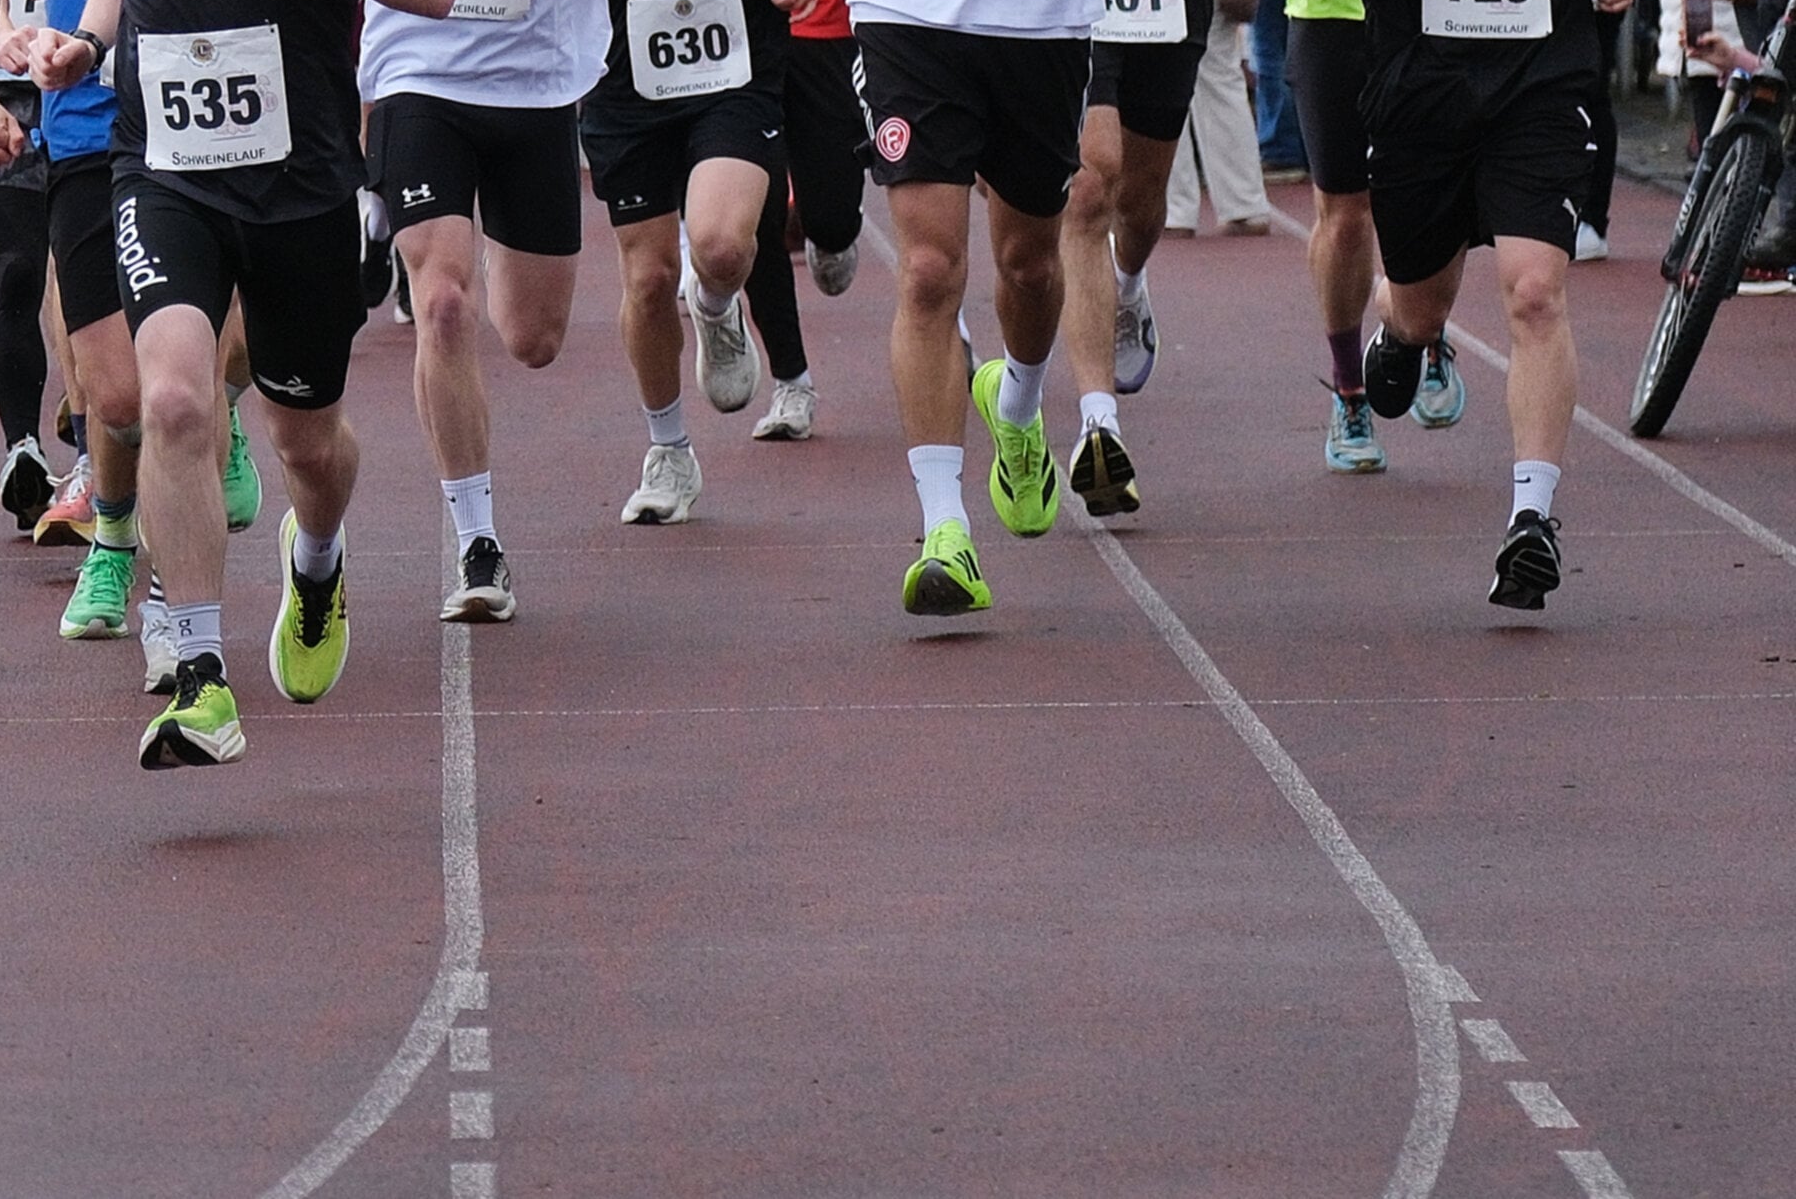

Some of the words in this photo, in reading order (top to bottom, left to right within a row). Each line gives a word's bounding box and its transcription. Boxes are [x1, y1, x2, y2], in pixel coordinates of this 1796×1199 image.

[648, 23, 730, 69] 630
[160, 74, 262, 131] 535
[171, 147, 266, 166] SCHWEINELAUF
